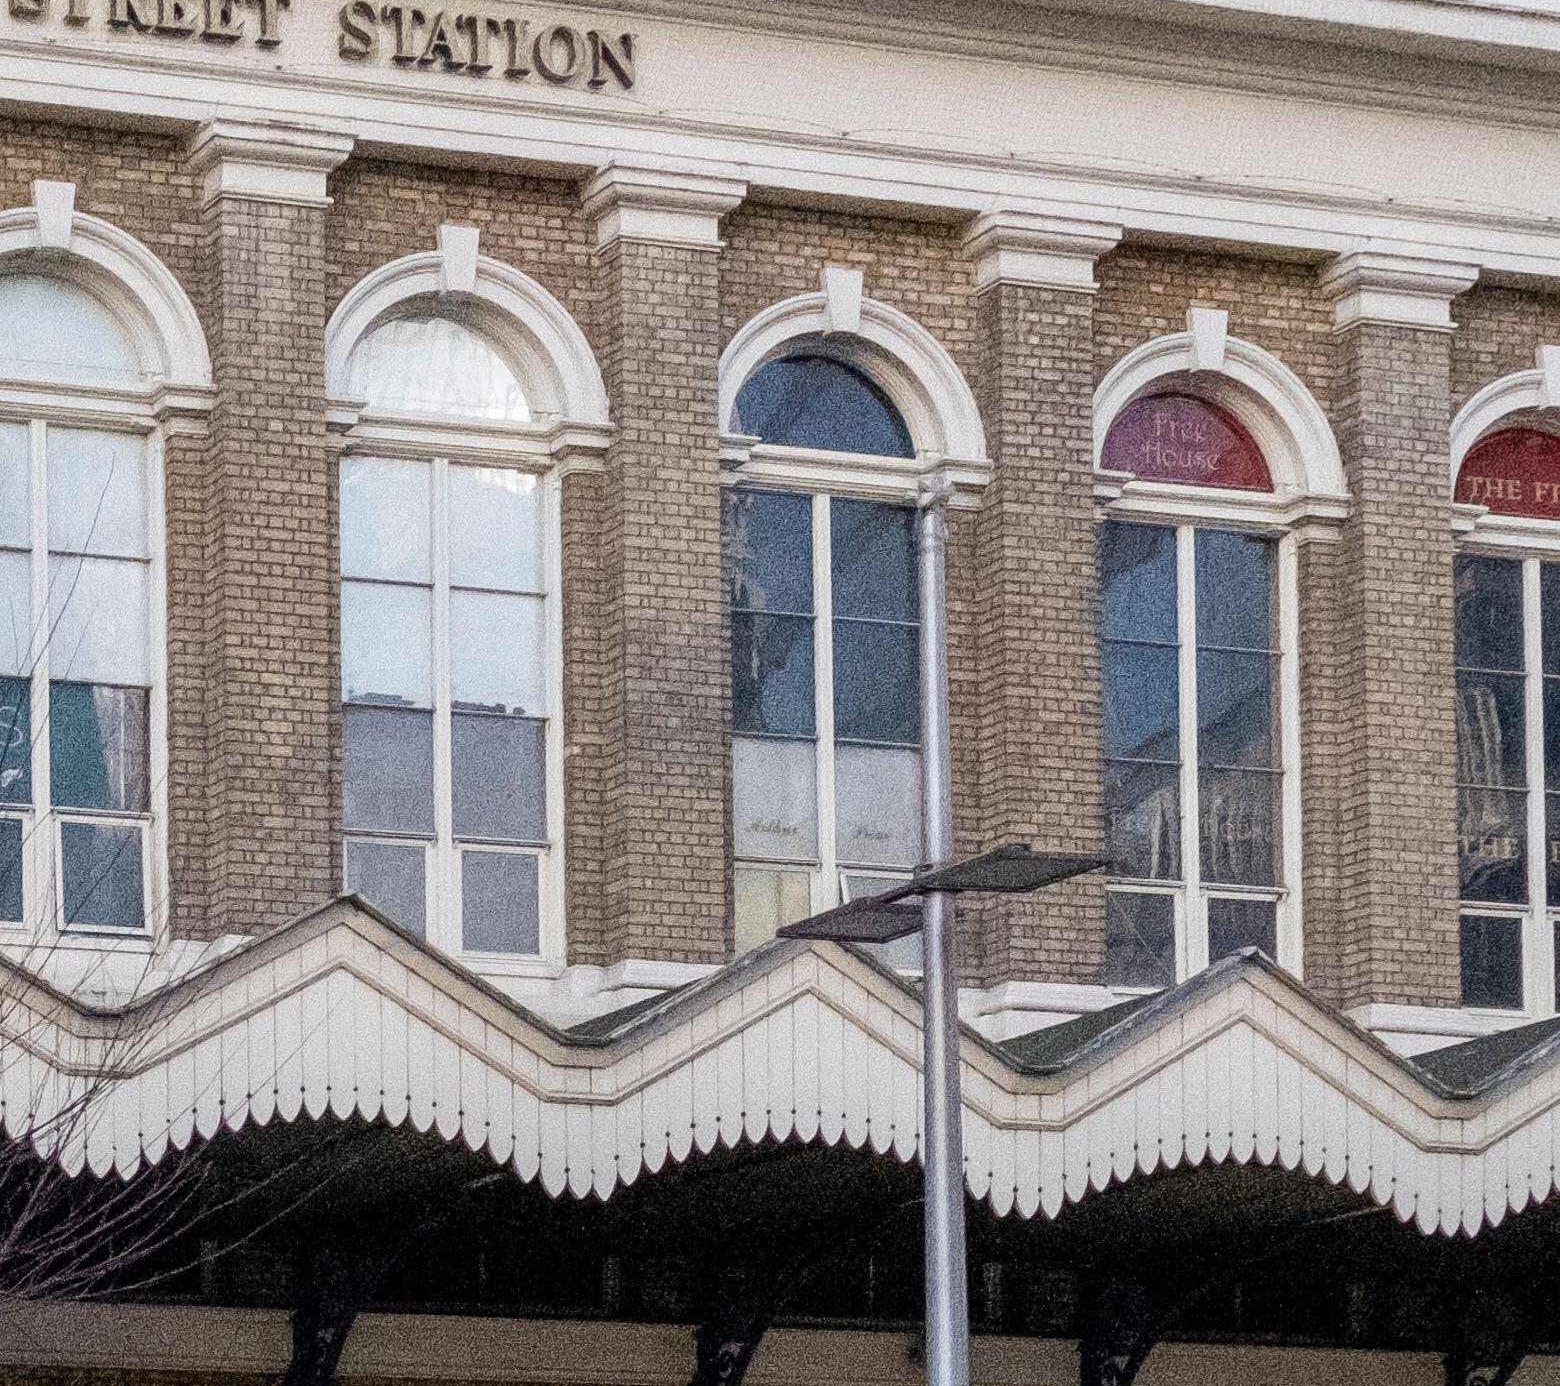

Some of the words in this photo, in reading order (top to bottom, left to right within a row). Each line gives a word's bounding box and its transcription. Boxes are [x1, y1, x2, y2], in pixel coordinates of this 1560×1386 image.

[338, 0, 640, 92] STATION
[1152, 412, 1207, 442] Free
[1141, 441, 1221, 470] House
[1466, 475, 1523, 502] THE
[1459, 835, 1519, 860] THE
